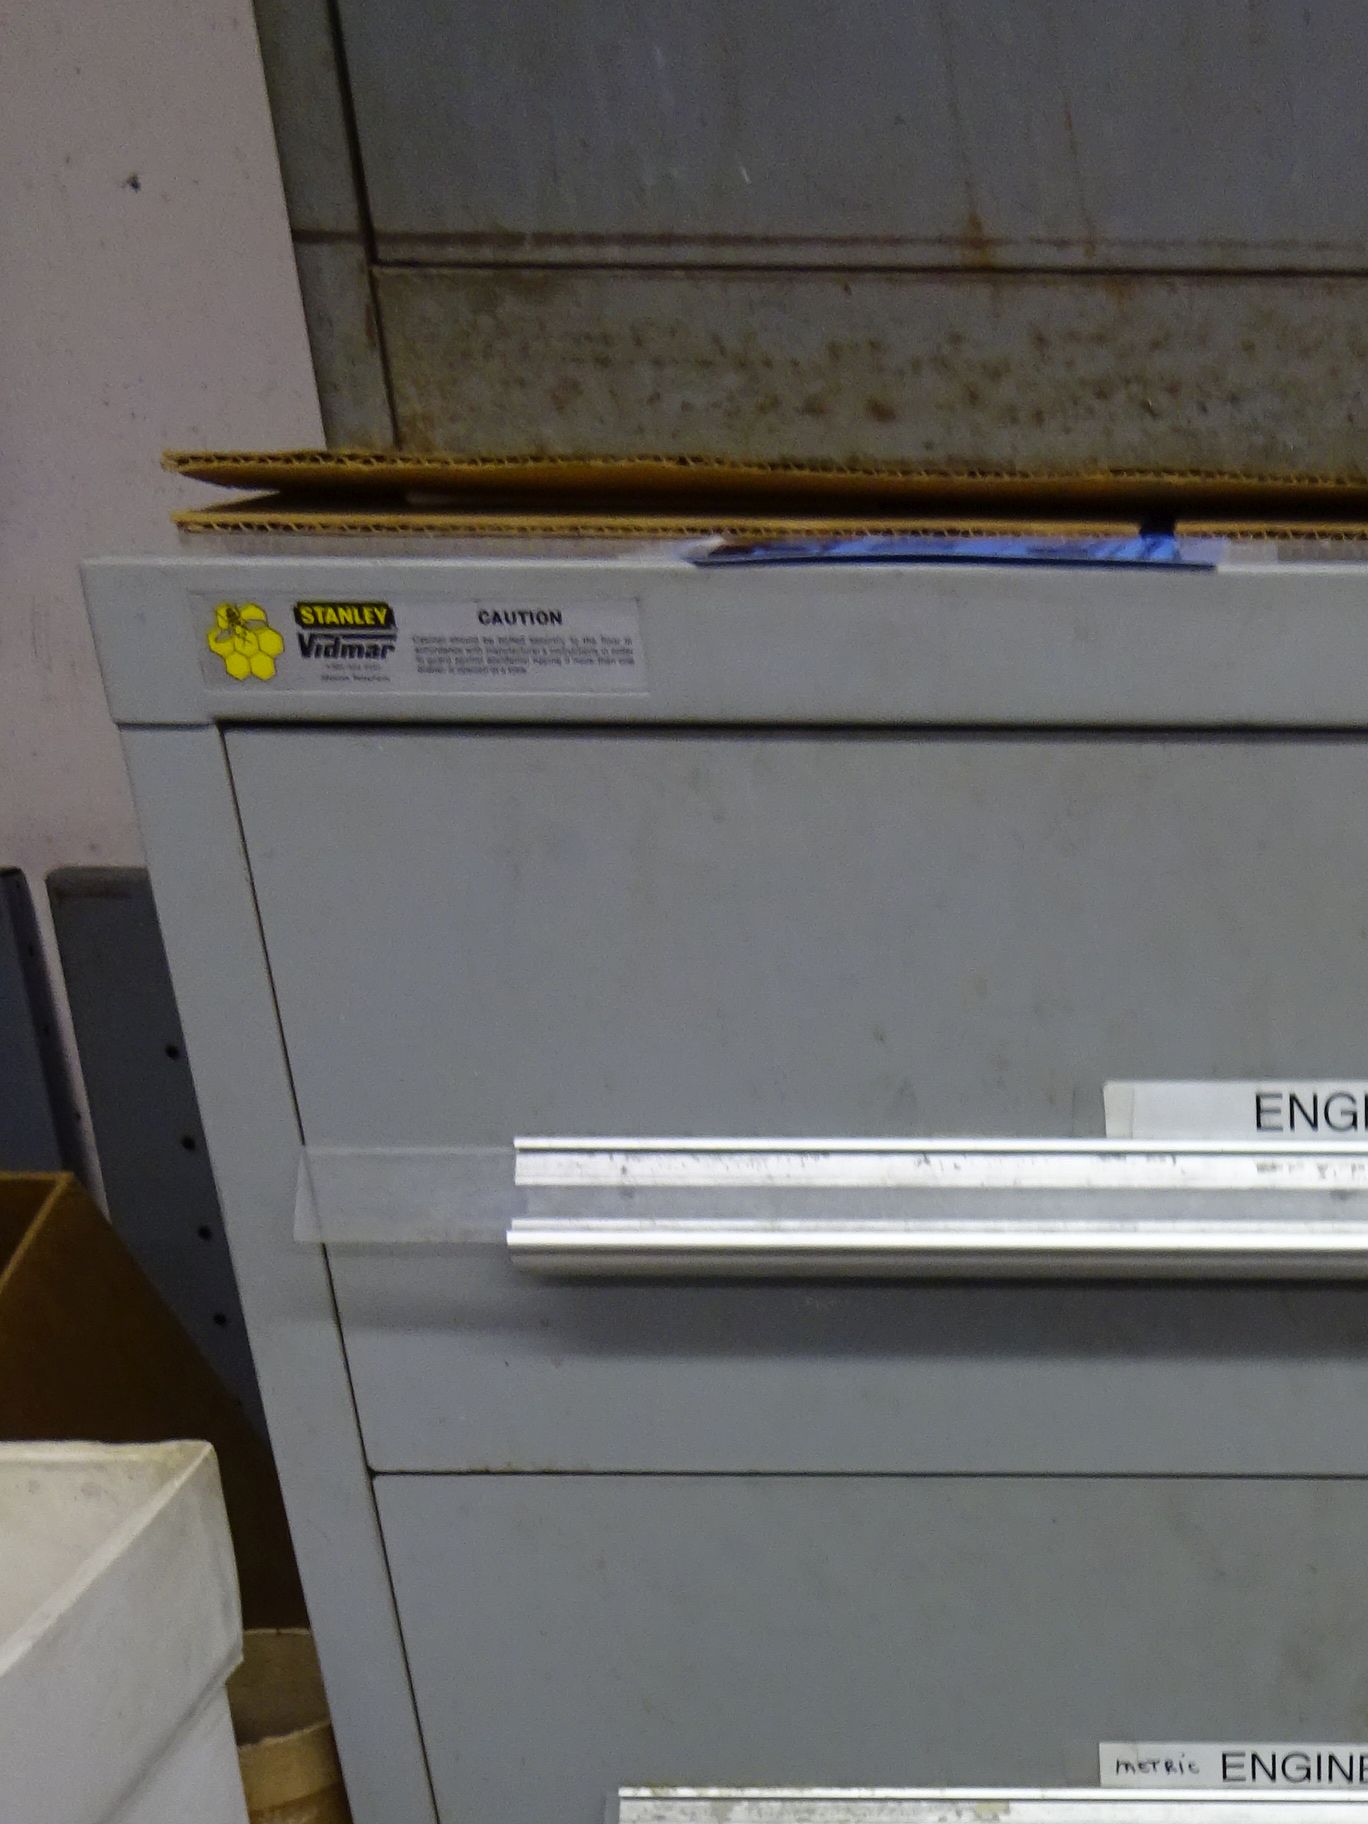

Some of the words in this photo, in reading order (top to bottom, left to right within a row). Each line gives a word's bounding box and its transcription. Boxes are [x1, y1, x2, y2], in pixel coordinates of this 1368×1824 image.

[301, 606, 387, 625] STANLEY
[478, 610, 563, 627] CAUTION
[298, 632, 396, 659] Vidmar
